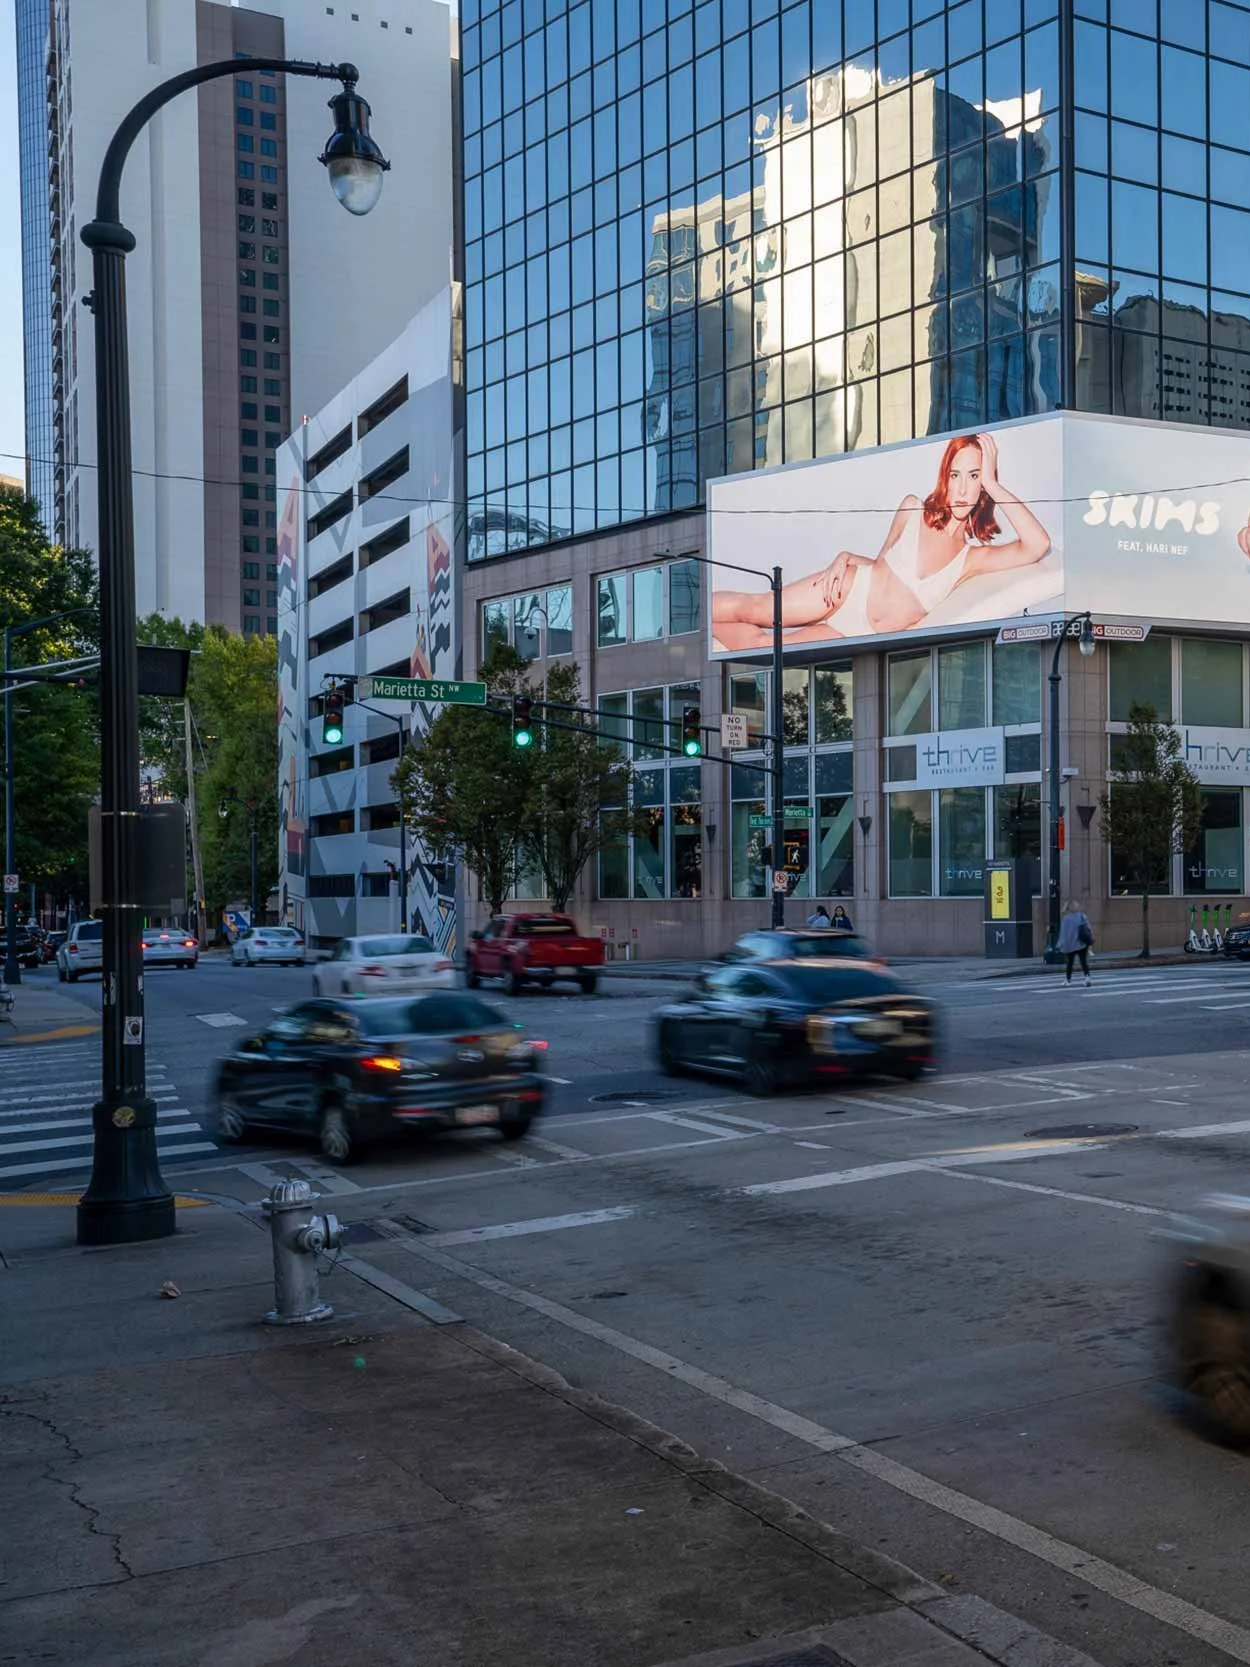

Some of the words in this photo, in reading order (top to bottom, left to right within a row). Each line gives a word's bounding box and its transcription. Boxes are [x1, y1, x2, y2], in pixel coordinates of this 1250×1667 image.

[1083, 490, 1221, 535] SKIMS
[1117, 540, 1143, 552] FEAT.
[1146, 543, 1169, 554] HARI
[1171, 545, 1189, 556] NEF
[1003, 629, 1016, 640] BIG
[1017, 627, 1048, 637] OUTDOOR
[1092, 626, 1103, 635] IG
[1106, 627, 1142, 636] OUTDOOR
[373, 681, 426, 697] Marietta
[430, 684, 445, 698] St
[448, 684, 460, 693] NW
[922, 735, 998, 767] thrive
[1186, 762, 1231, 771] STAURANT
